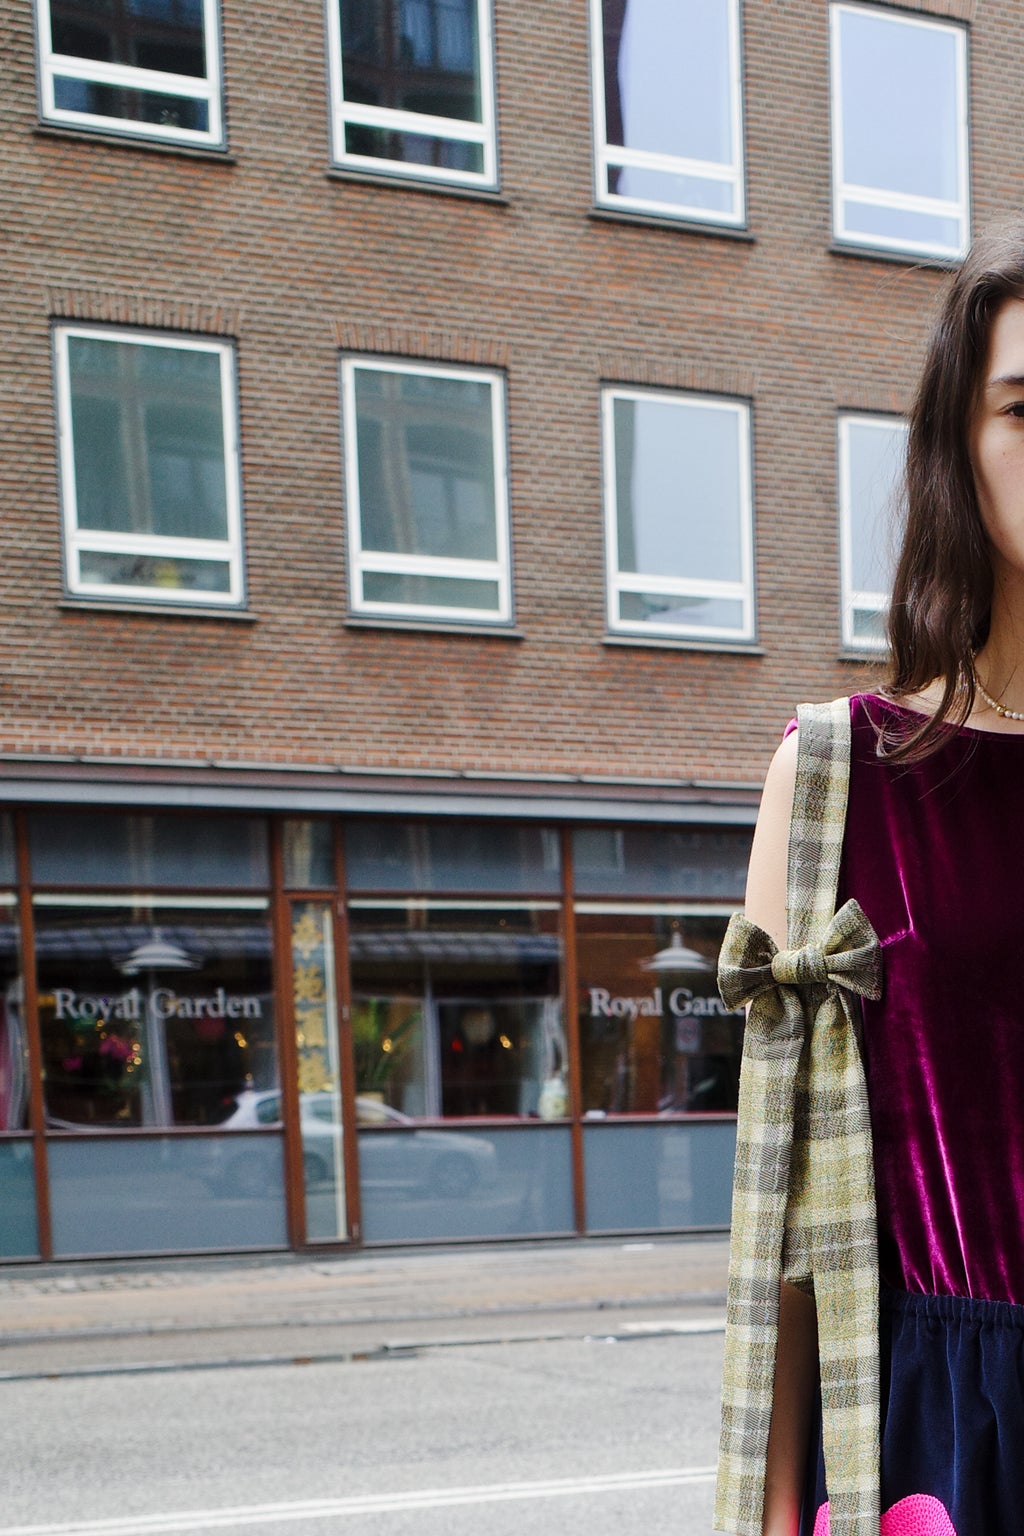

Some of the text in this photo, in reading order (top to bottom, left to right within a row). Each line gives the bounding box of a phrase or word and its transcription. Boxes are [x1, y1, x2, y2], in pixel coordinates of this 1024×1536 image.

[54, 988, 262, 1020] Royal Garden
[590, 988, 745, 1019] Royal Gar
